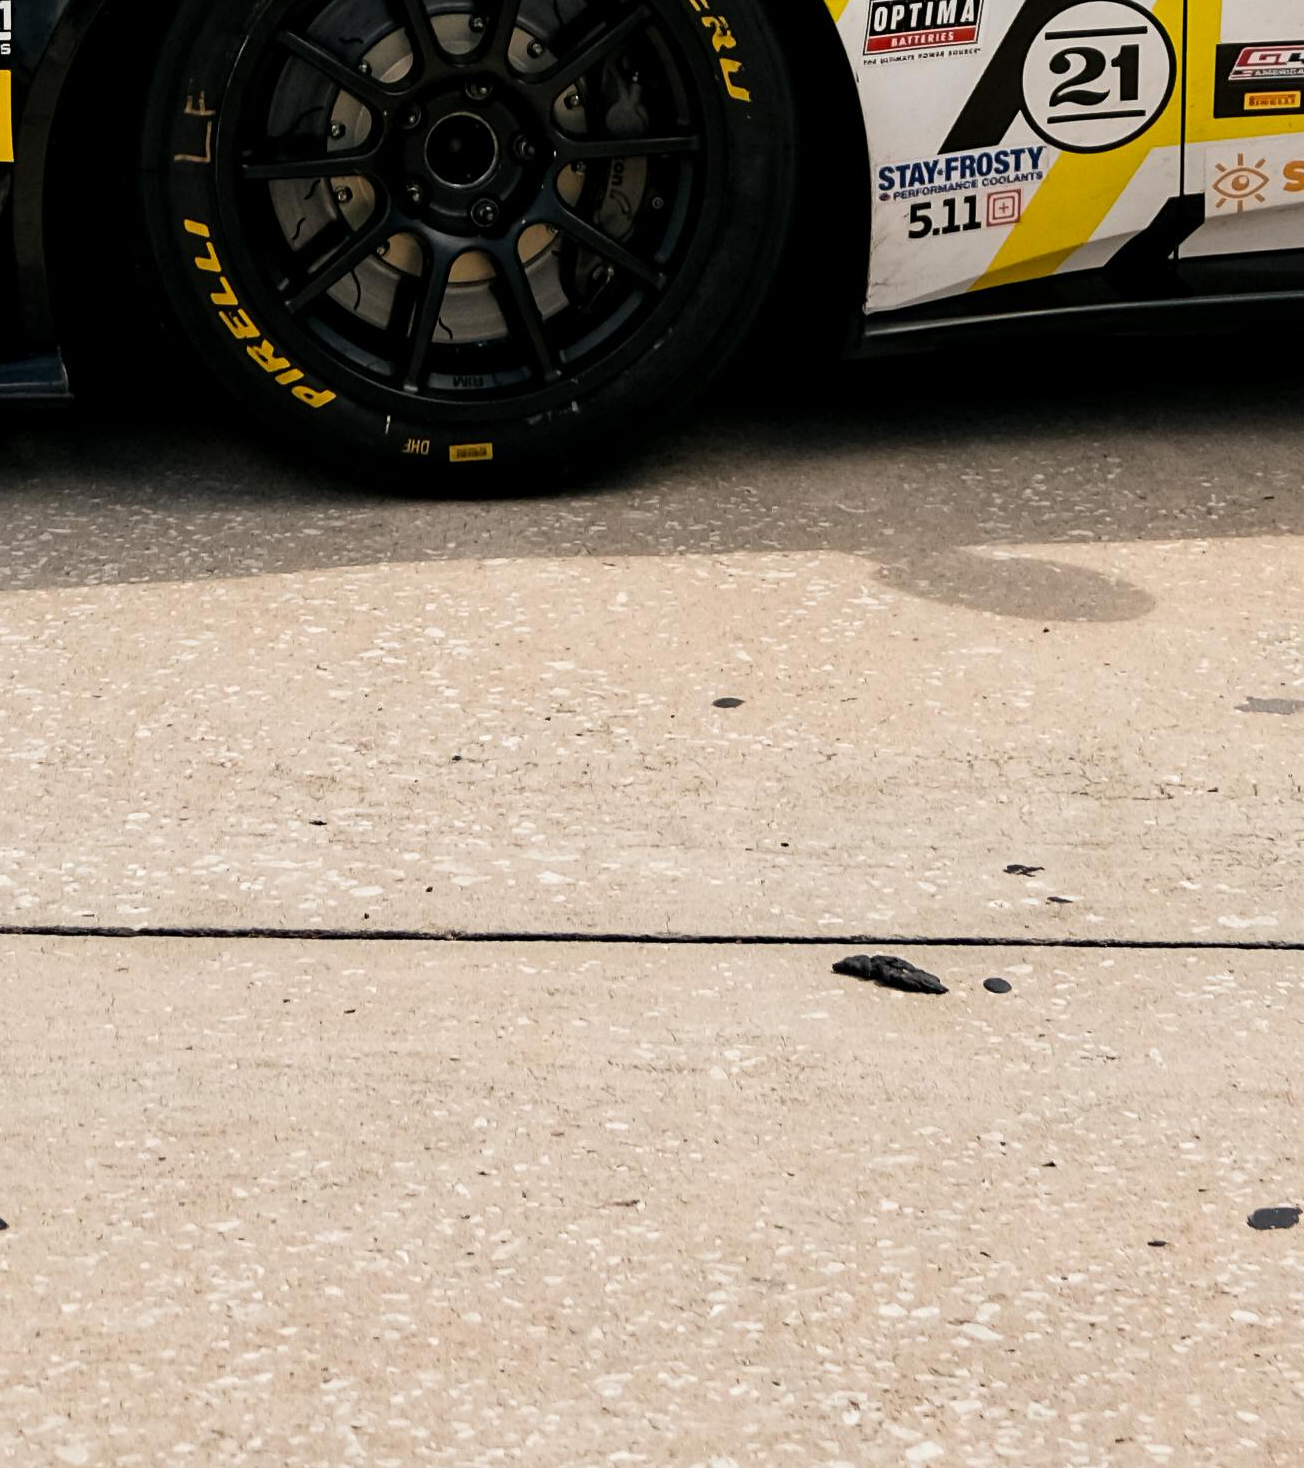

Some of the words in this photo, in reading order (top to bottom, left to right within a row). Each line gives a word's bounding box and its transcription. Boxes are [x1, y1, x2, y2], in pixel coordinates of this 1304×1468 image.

[891, 31, 955, 48] BATTERIES
[1048, 43, 1140, 108] 21
[893, 179, 979, 200] PERFORMANCE
[982, 170, 1044, 188] COOLANTS
[908, 194, 982, 239] 5.11
[183, 217, 337, 409] PIRELLI
